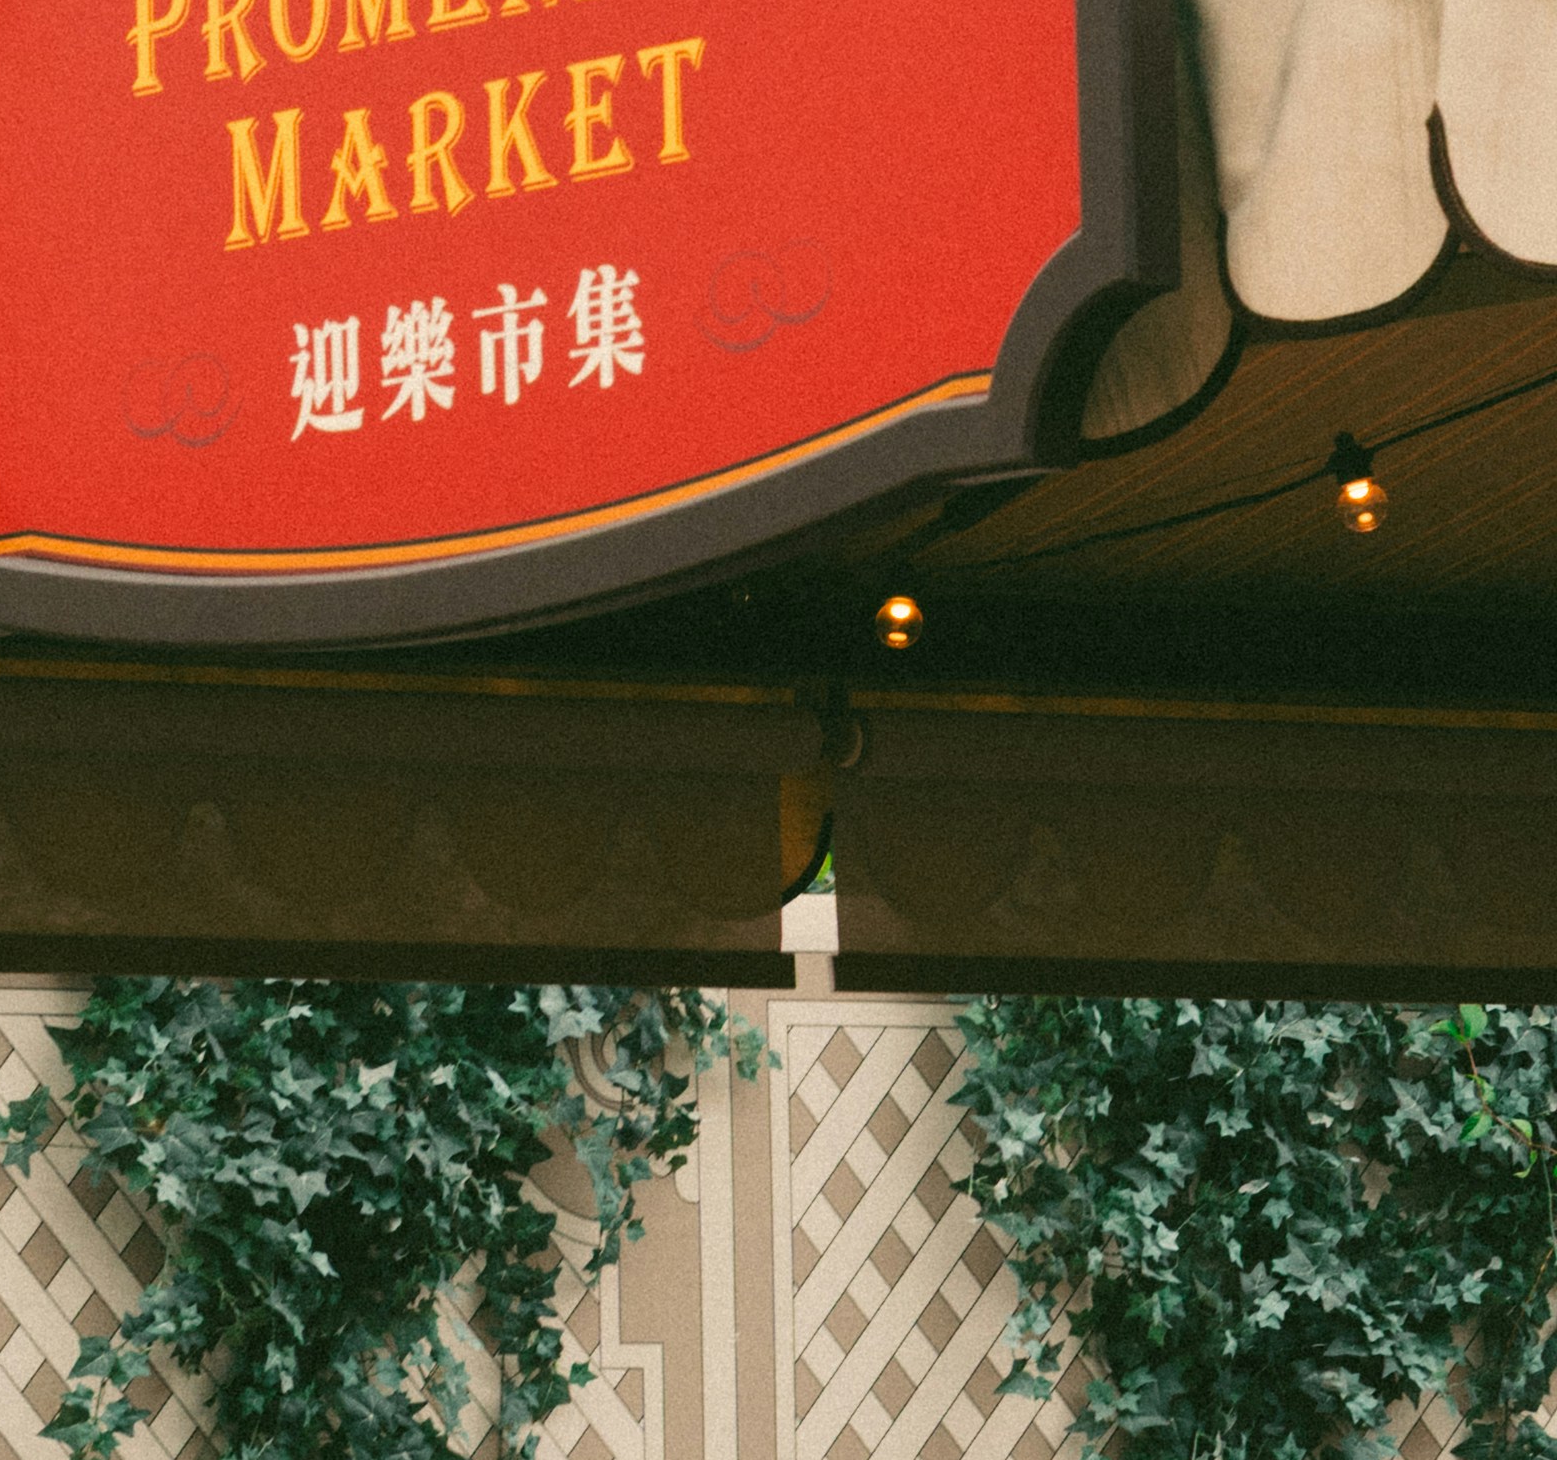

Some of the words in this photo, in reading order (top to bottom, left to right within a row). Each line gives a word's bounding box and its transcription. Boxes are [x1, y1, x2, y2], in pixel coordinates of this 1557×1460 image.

[224, 37, 705, 251] MARKET
[288, 263, 646, 442] 迎樂市集
